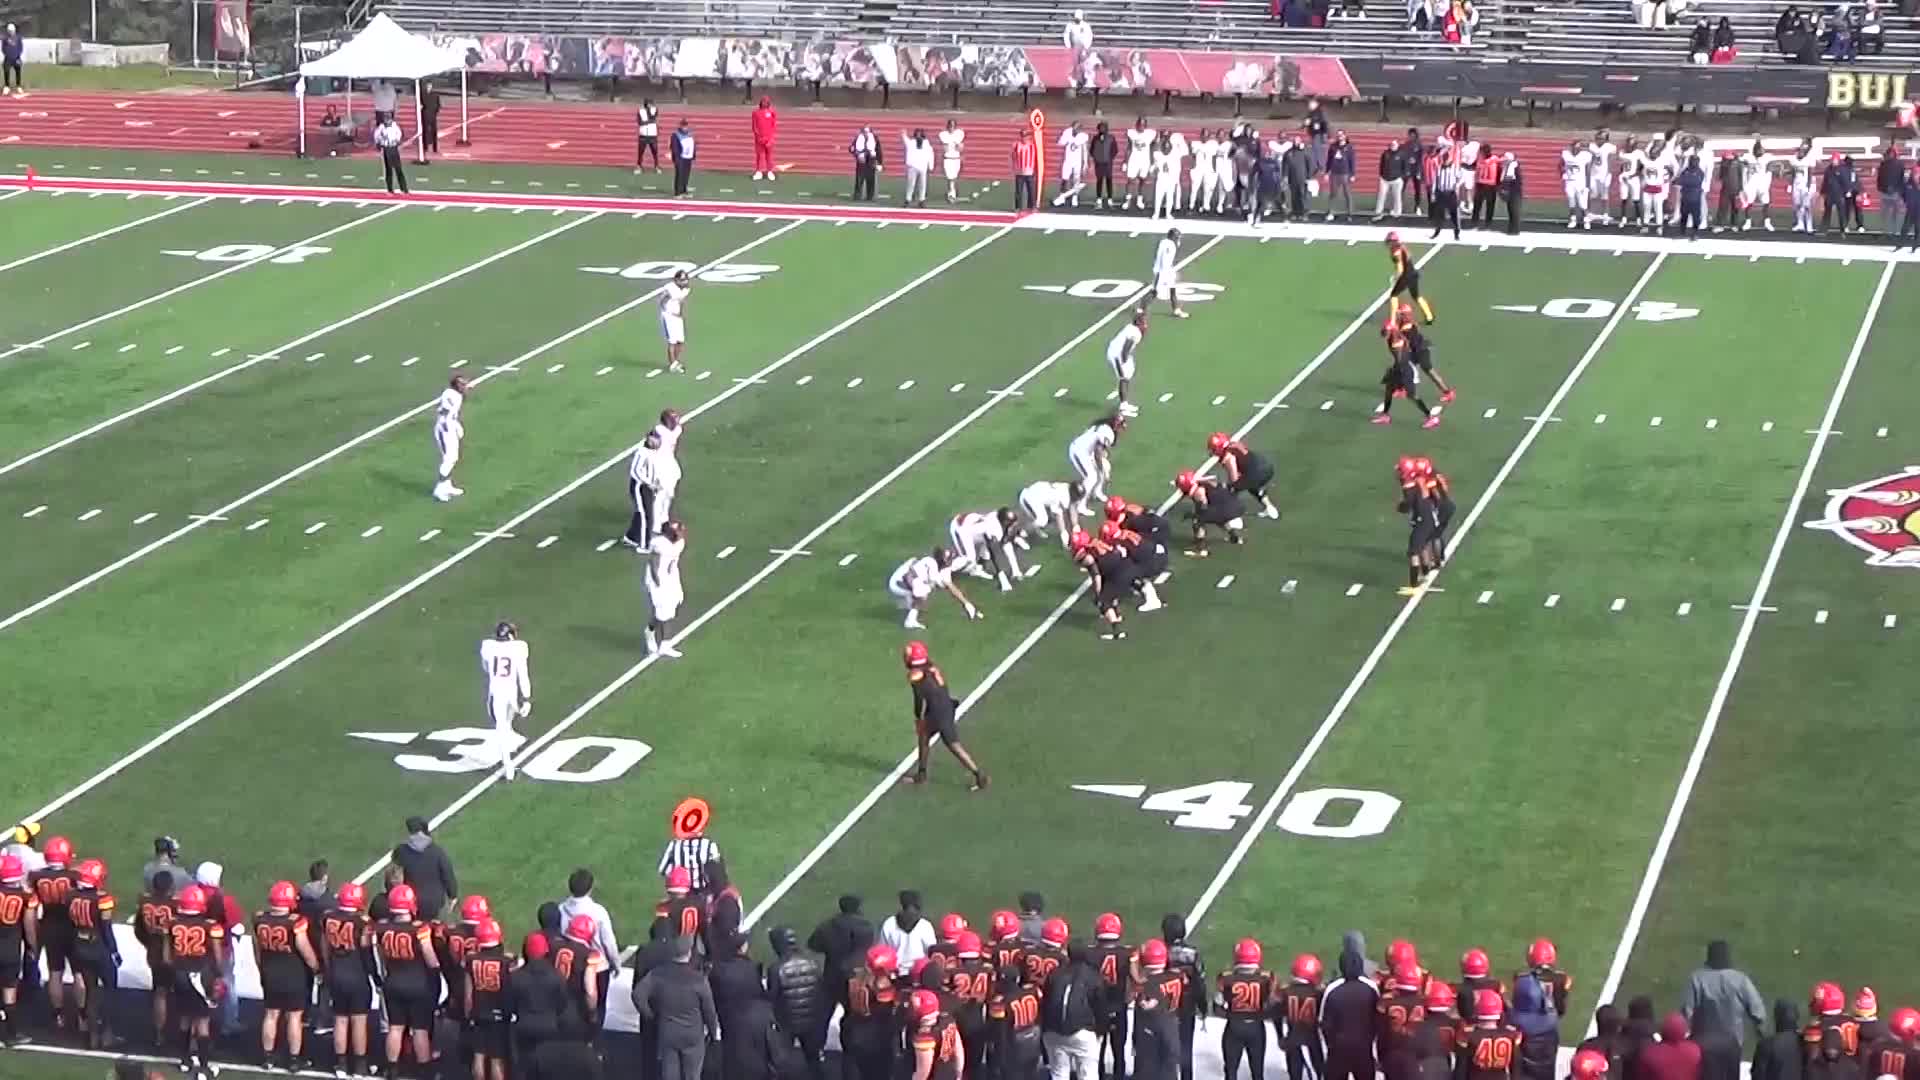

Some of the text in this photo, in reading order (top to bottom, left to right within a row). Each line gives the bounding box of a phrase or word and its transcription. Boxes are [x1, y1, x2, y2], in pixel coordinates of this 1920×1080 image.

[1827, 72, 1913, 108] BUL
[493, 656, 512, 677] 13
[1141, 780, 1402, 838] 40
[172, 924, 207, 956] 32
[1230, 982, 1261, 1014] 21
[1287, 995, 1318, 1023] 14
[1474, 1036, 1513, 1070] 49
